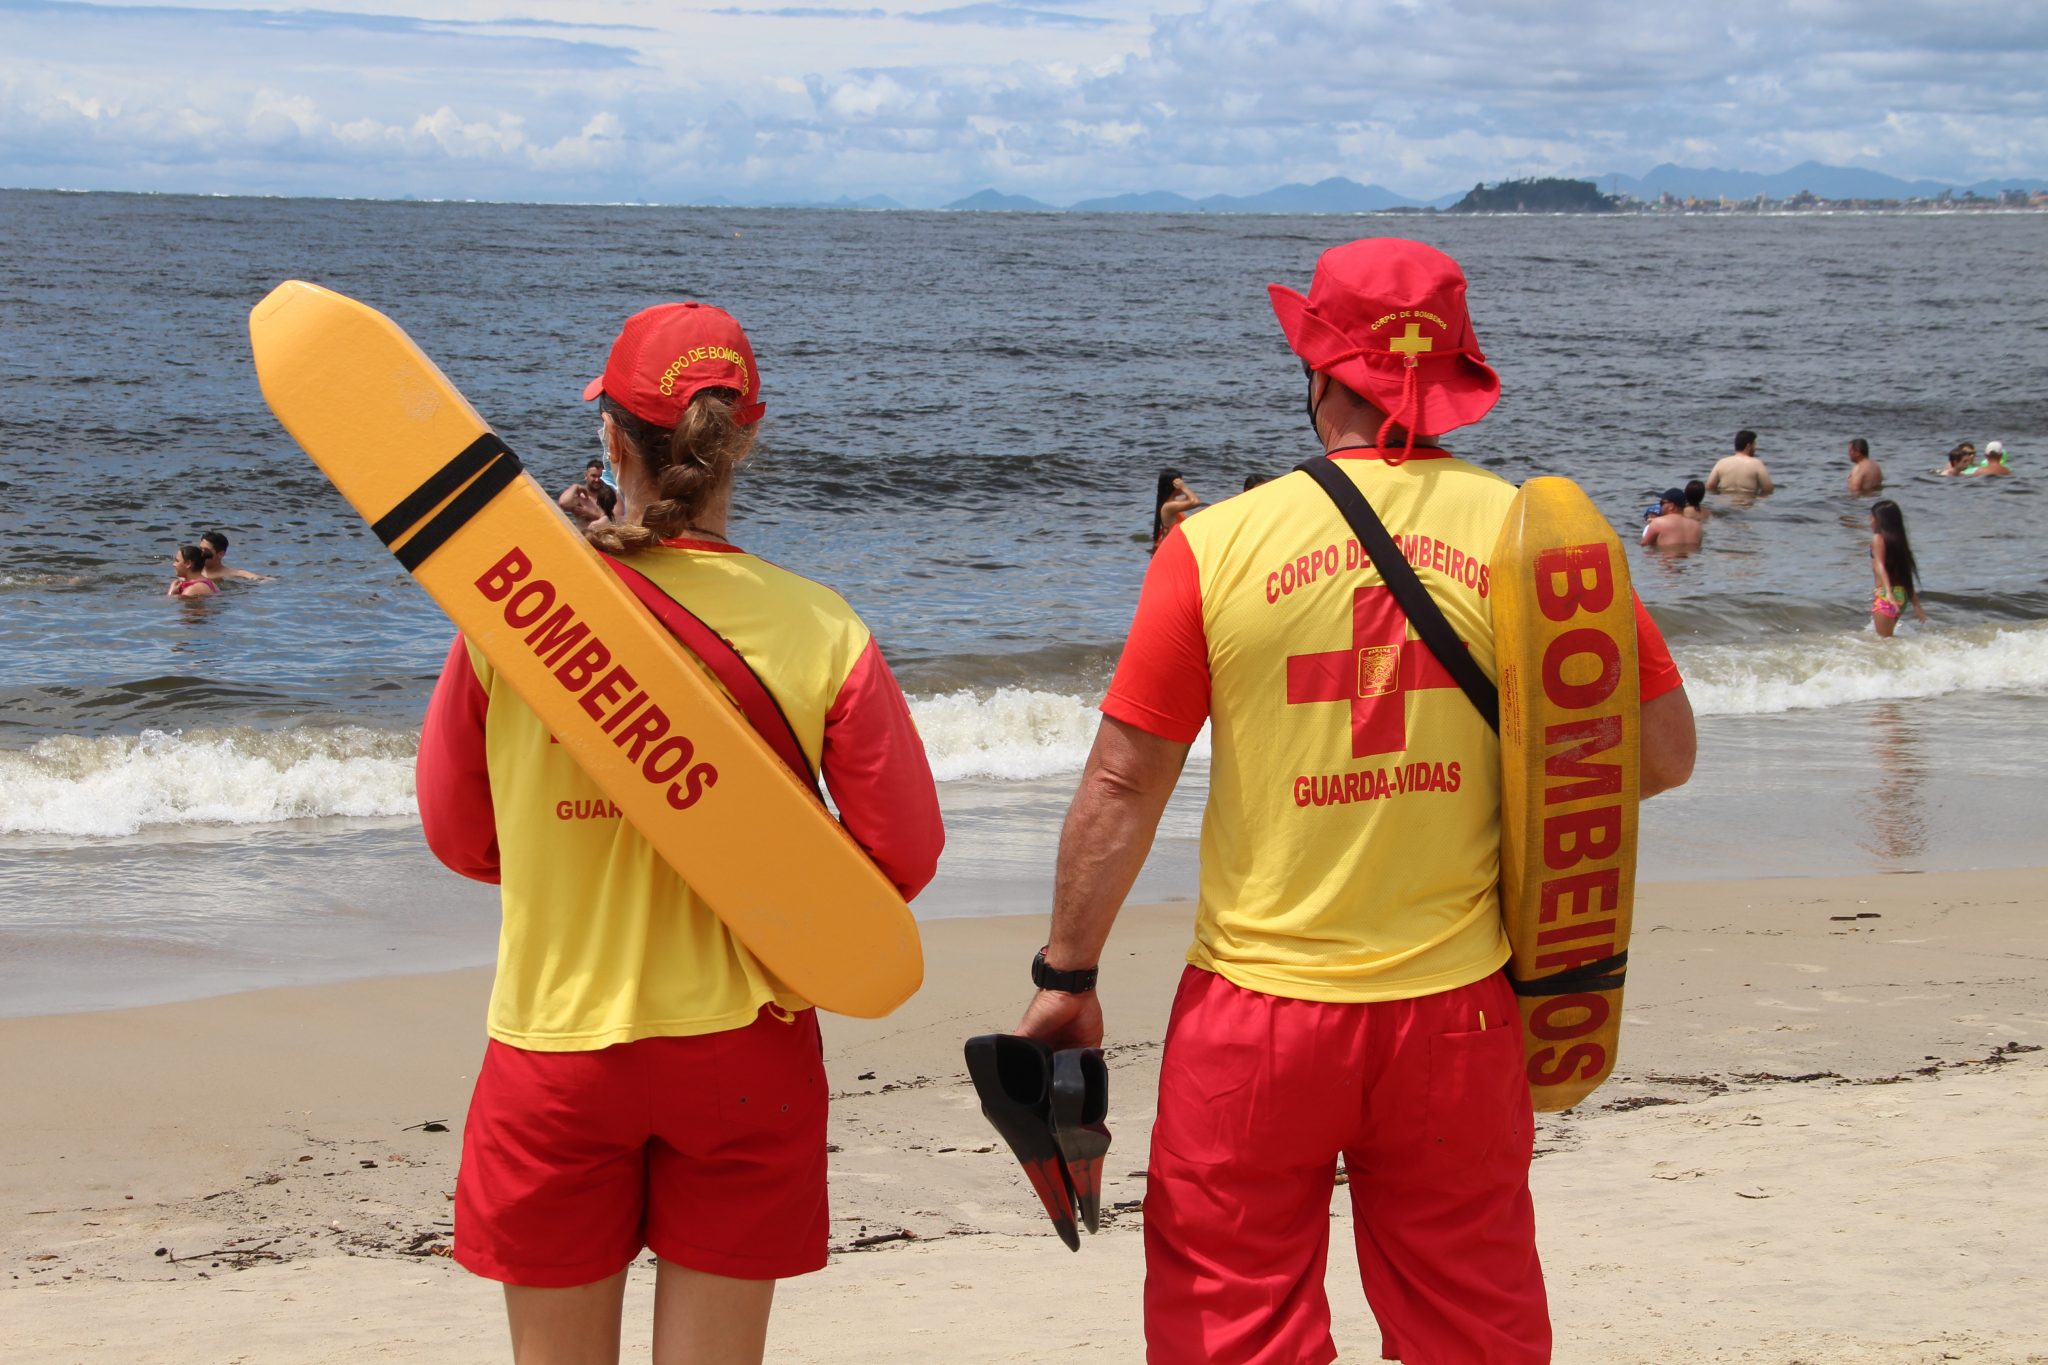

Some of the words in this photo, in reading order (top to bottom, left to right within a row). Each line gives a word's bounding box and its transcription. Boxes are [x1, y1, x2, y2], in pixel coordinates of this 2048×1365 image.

[1371, 313, 1396, 330] CORPO
[659, 355, 690, 396] CORPO
[688, 347, 708, 363] DE
[1266, 544, 1339, 604] CORPO
[1346, 538, 1371, 571] DE
[1392, 533, 1490, 599] MBEIROS
[474, 546, 719, 810] BOMBEIROS
[1293, 761, 1462, 807] GUARDA-VIDAS
